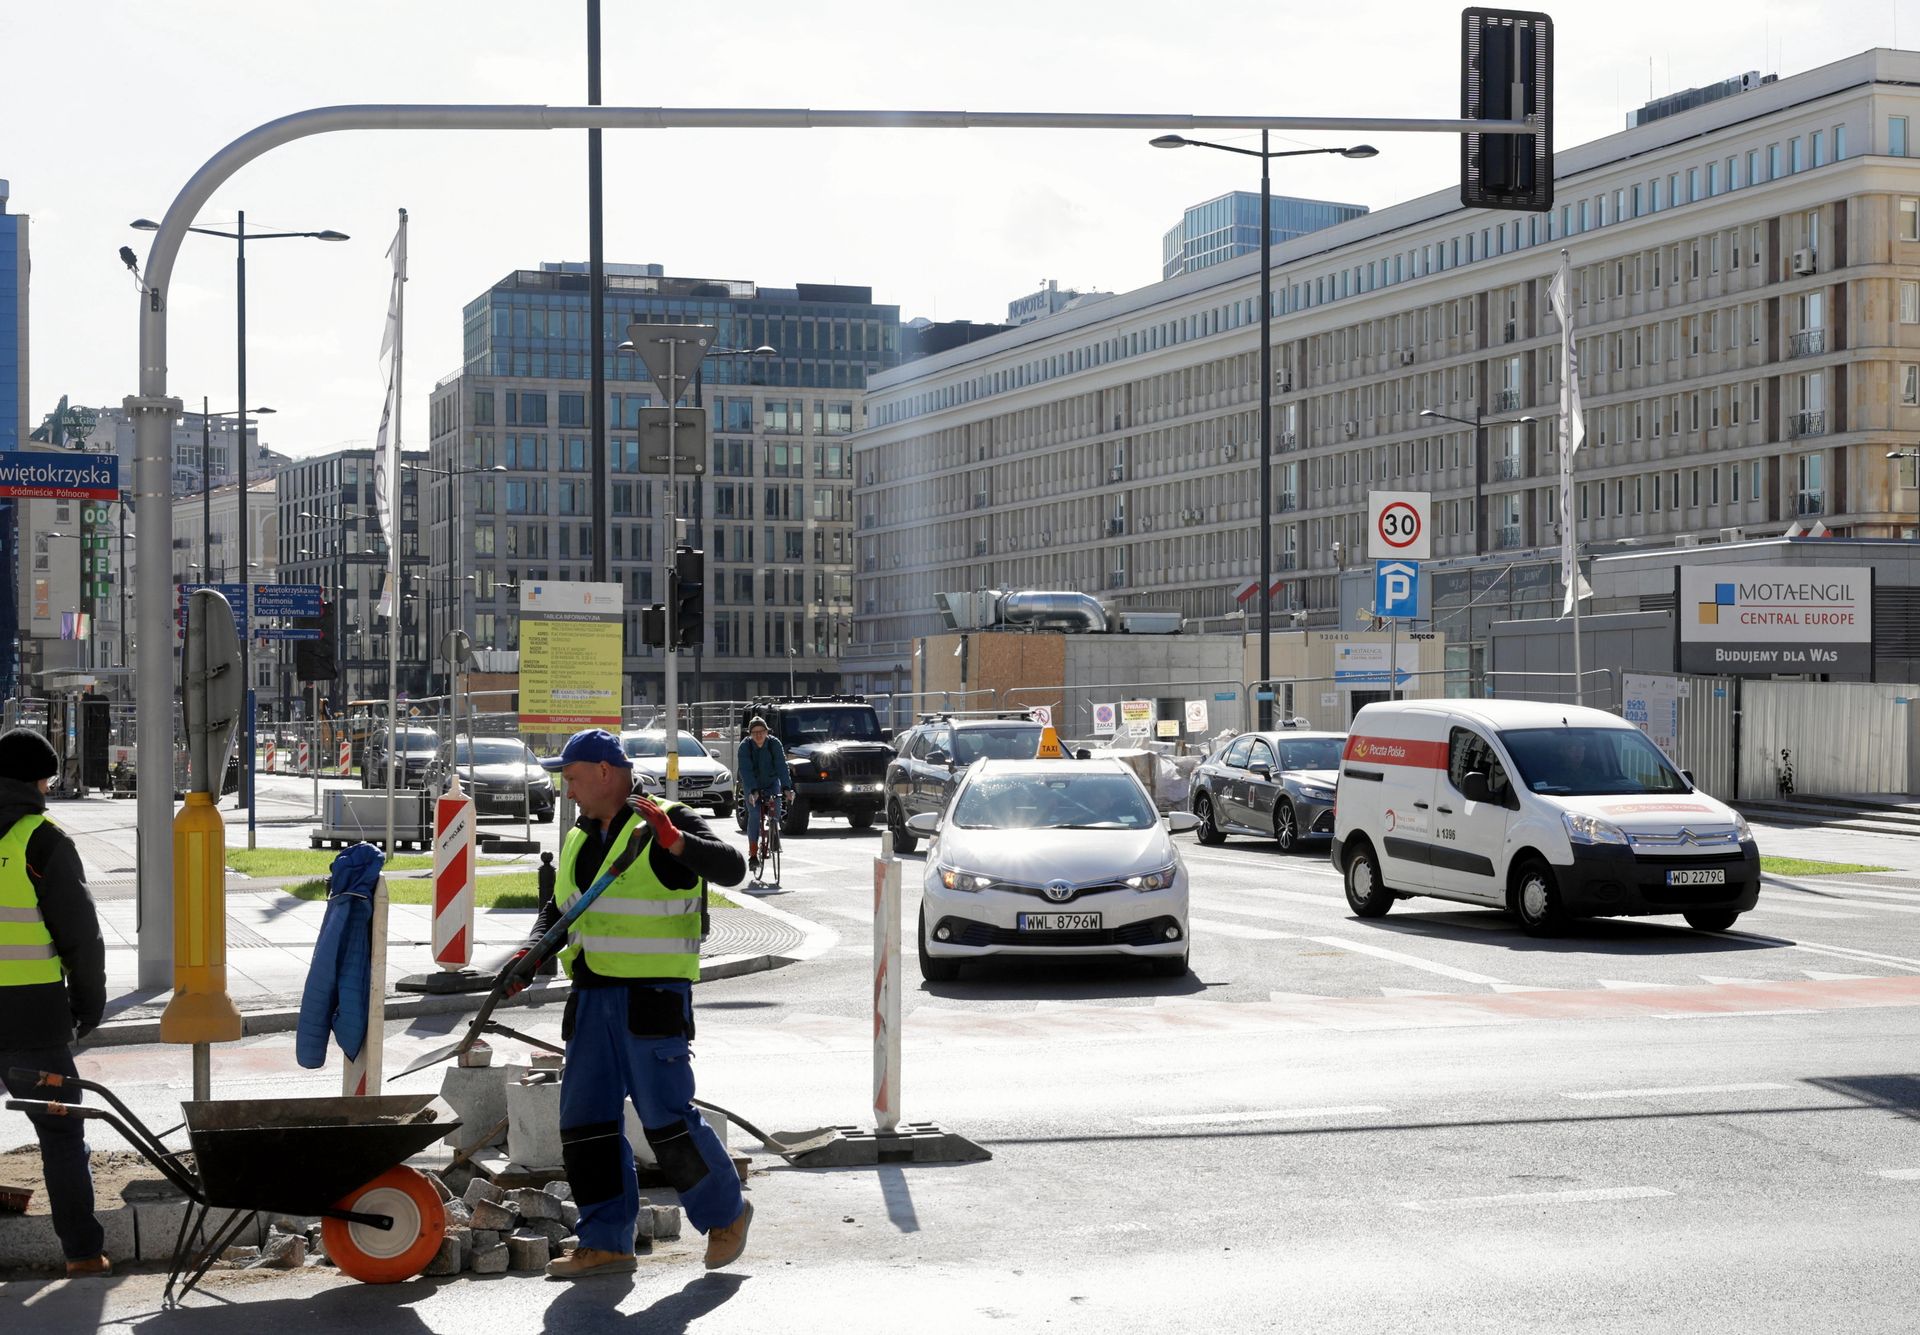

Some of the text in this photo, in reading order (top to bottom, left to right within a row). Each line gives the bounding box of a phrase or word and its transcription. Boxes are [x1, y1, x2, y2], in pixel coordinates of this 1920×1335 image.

[1010, 293, 1046, 319] NOVOTEL
[96, 456, 113, 464] 1-21
[0, 463, 111, 487] więtokrzyska
[10, 486, 90, 498] Śródmieście Północne
[1384, 513, 1415, 536] 30
[1385, 574, 1410, 610] P
[257, 597, 293, 605] Filharmonia
[257, 607, 279, 615] Poczta
[280, 607, 305, 615] Główna
[1740, 612, 1855, 625] CENTRAL EUROPE
[1124, 702, 1149, 710] UWAGA
[1369, 744, 1406, 757] Poczta Polska
[1436, 829, 1440, 838] A
[1442, 829, 1456, 840] 1396
[1, 857, 9, 867] T
[1673, 870, 1723, 884] WD 2279C
[1027, 915, 1098, 929] WWL 8796W
